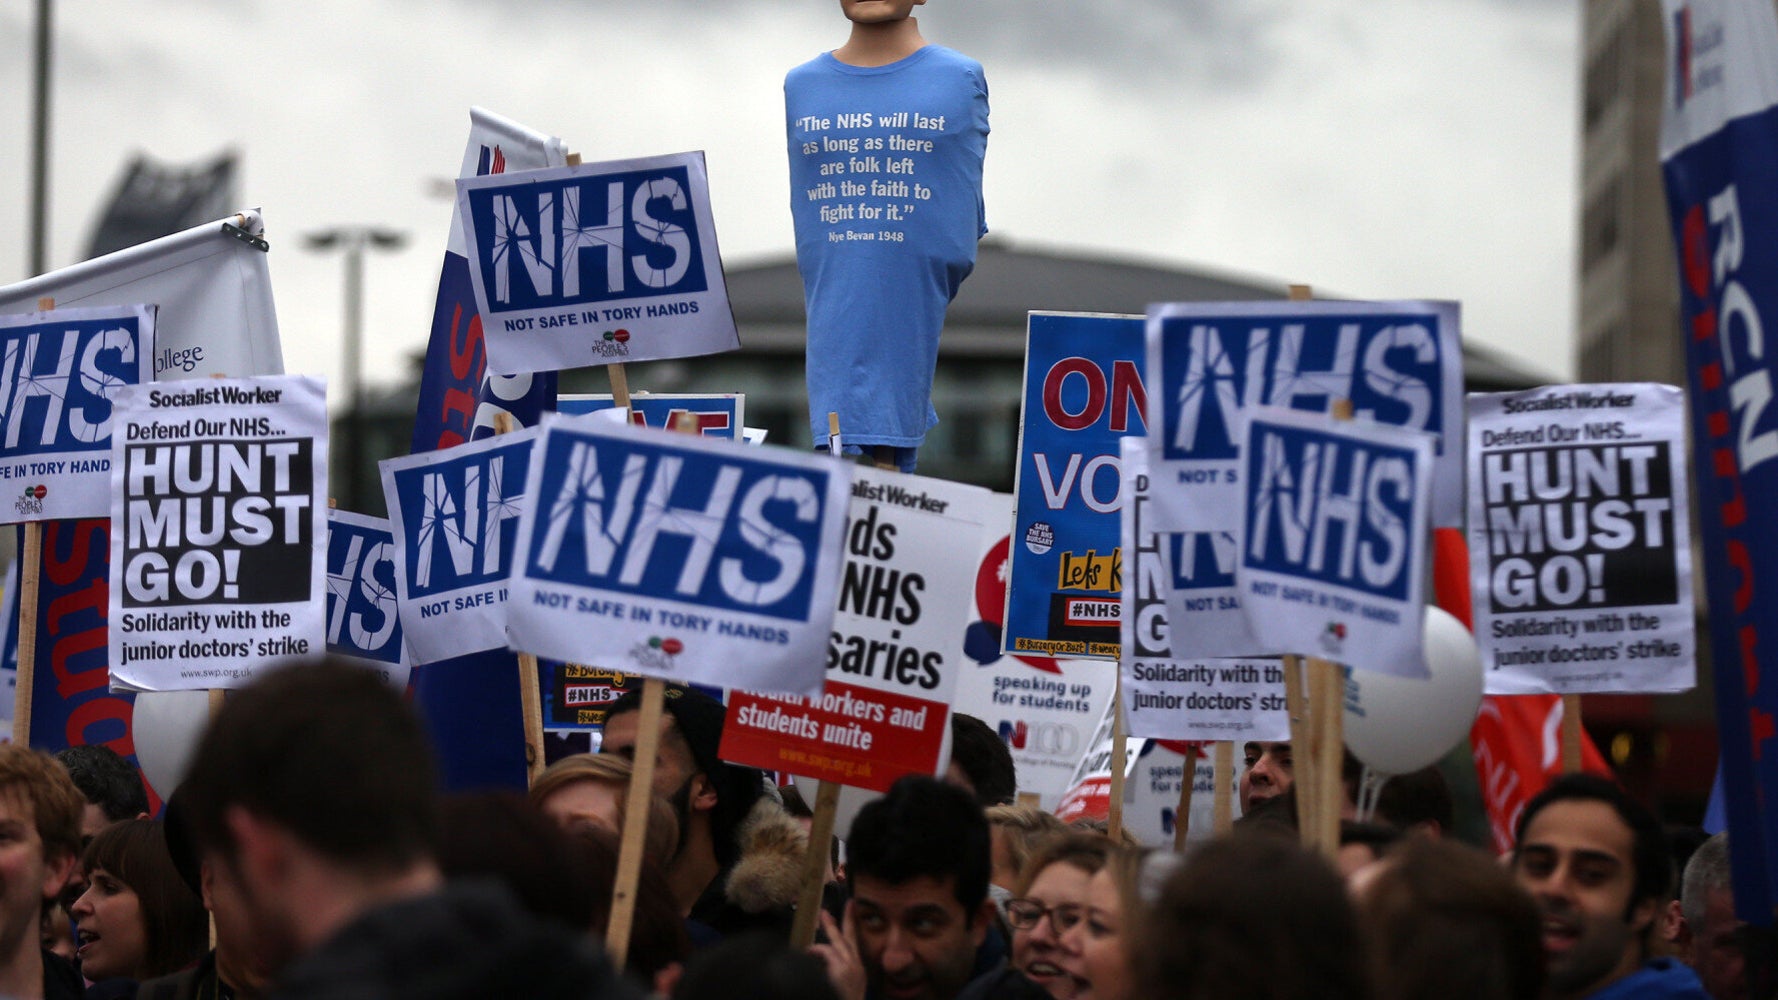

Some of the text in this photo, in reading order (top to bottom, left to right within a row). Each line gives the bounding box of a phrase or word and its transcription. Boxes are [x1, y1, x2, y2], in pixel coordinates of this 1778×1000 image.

[837, 113, 873, 129] NHS
[879, 113, 908, 128] will
[913, 112, 945, 131] last
[802, 134, 933, 155] as long as there
[820, 157, 914, 176] are folk left
[807, 180, 931, 201] with the faith to
[820, 204, 853, 224] fight
[858, 204, 882, 220] for
[492, 176, 691, 304] NHS
[829, 231, 904, 243] Nye Bevan 1948
[504, 301, 700, 331] NOT SAFE IN TORY HANDS
[1708, 183, 1778, 474] RCN
[149, 386, 282, 408] Socialist Worker
[1174, 324, 1436, 451] NHS
[126, 419, 190, 441] Defend
[194, 418, 226, 437] Our
[1482, 424, 1544, 447] Defend
[1548, 423, 1579, 442] Our
[15, 464, 27, 478] IN
[30, 461, 66, 476] TORY
[70, 459, 112, 474] HAND
[128, 442, 299, 496] HUNT
[1034, 453, 1122, 513] VO
[1178, 470, 1219, 483] NOT
[1486, 445, 1658, 502] HUNT
[886, 485, 949, 514] Worker
[1250, 432, 1412, 588] NHS
[128, 495, 310, 549] MUST
[416, 456, 523, 588] NH
[538, 441, 819, 606] NHS
[1489, 498, 1670, 556] MUST
[125, 549, 240, 601] GO!
[326, 529, 398, 650] HS
[1492, 553, 1606, 608] GO!
[420, 600, 450, 618] NOT
[455, 591, 494, 611] SAFE
[838, 560, 925, 625] NHS
[1185, 598, 1215, 611] NOT
[121, 610, 291, 633] Solidarity with the
[533, 590, 790, 645] NOT SAFE IN TORY HANDS
[1491, 612, 1660, 638] Solidarity with the
[121, 641, 176, 666] junior
[257, 636, 308, 656] strike
[828, 629, 943, 690] saries
[1492, 647, 1545, 670] junior
[1626, 639, 1682, 659] strike
[994, 676, 1091, 698] speaking up
[1133, 662, 1285, 686] Solidarity with th
[568, 688, 611, 702] #NHS
[993, 689, 1090, 712] for students
[1133, 690, 1185, 711] junior
[737, 703, 873, 750] students unite
[889, 706, 927, 731] and
